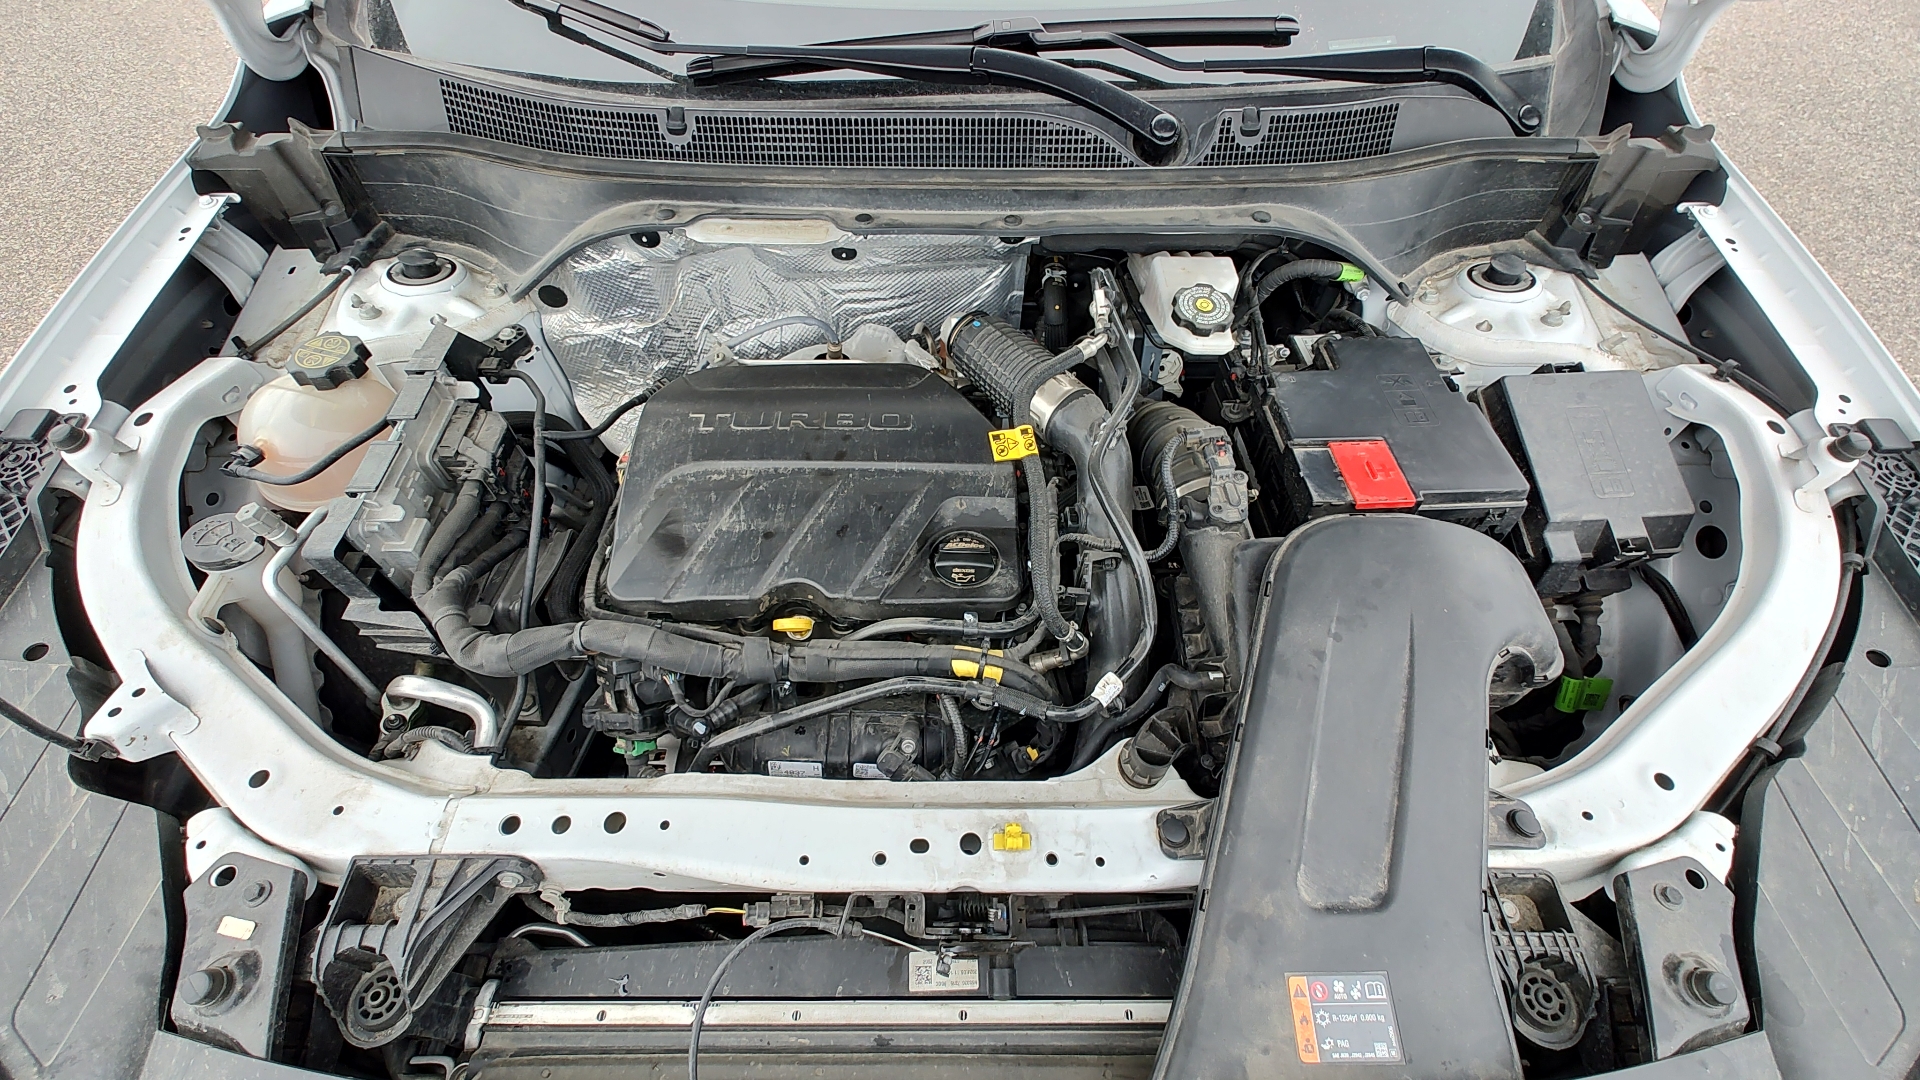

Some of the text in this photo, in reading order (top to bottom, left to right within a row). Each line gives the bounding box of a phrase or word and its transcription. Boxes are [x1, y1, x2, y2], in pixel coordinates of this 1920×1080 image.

[688, 411, 915, 432] TURBO
[1377, 1014, 1385, 1023] kg
[1337, 1040, 1350, 1048] PAG
